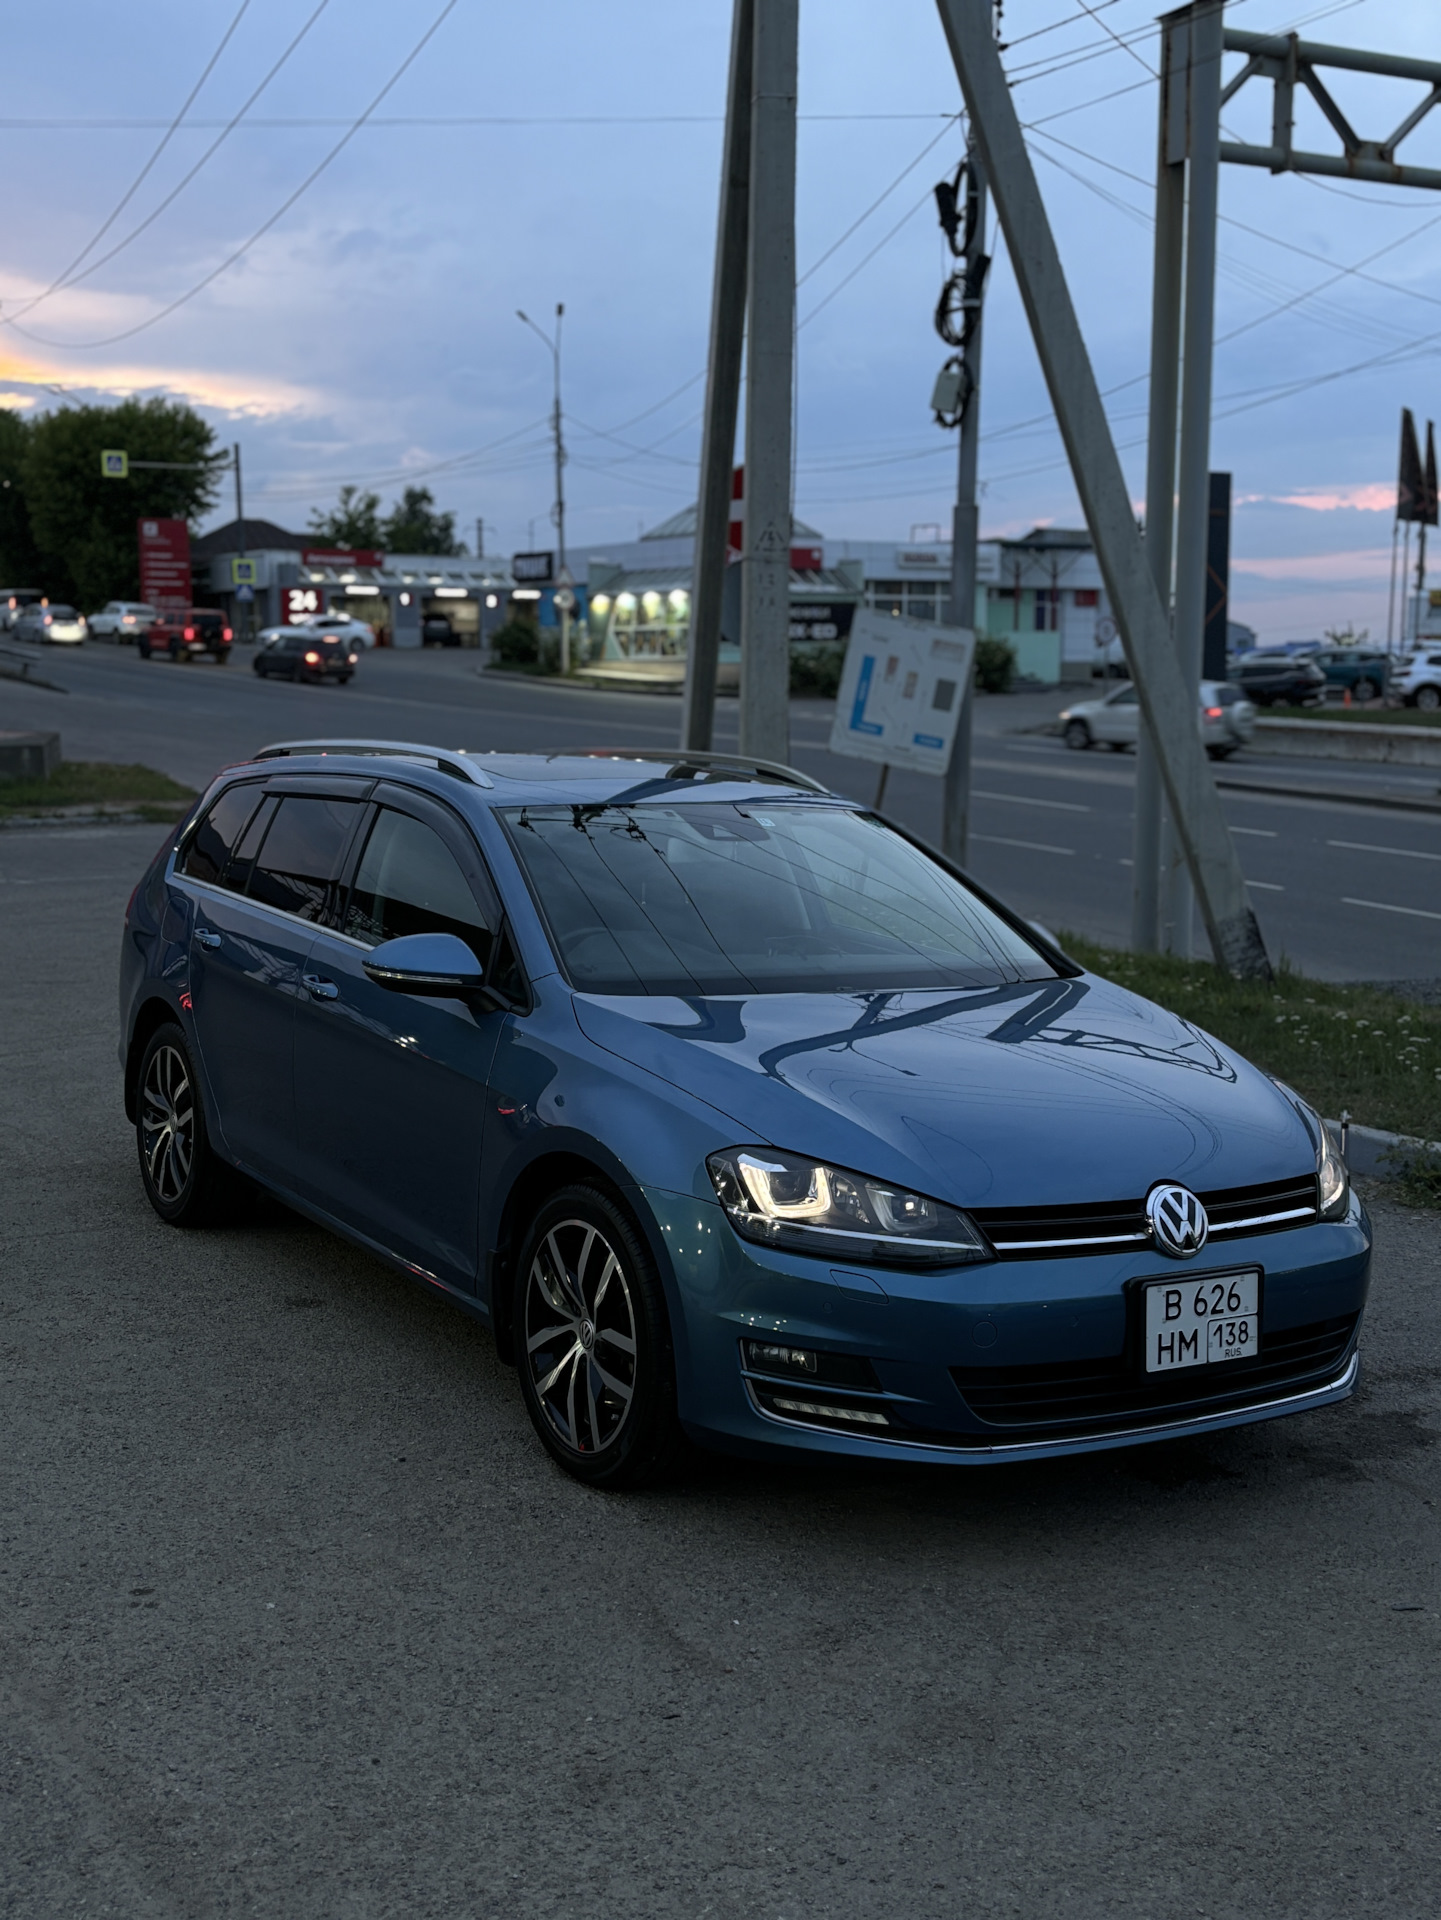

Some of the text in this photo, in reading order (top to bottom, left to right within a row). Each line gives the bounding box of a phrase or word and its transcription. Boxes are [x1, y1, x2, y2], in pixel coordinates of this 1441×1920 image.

[288, 589, 318, 611] 24
[1165, 1281, 1241, 1320] В 626
[1157, 1321, 1249, 1365] НМ 138
[1224, 1347, 1242, 1358] RUS
